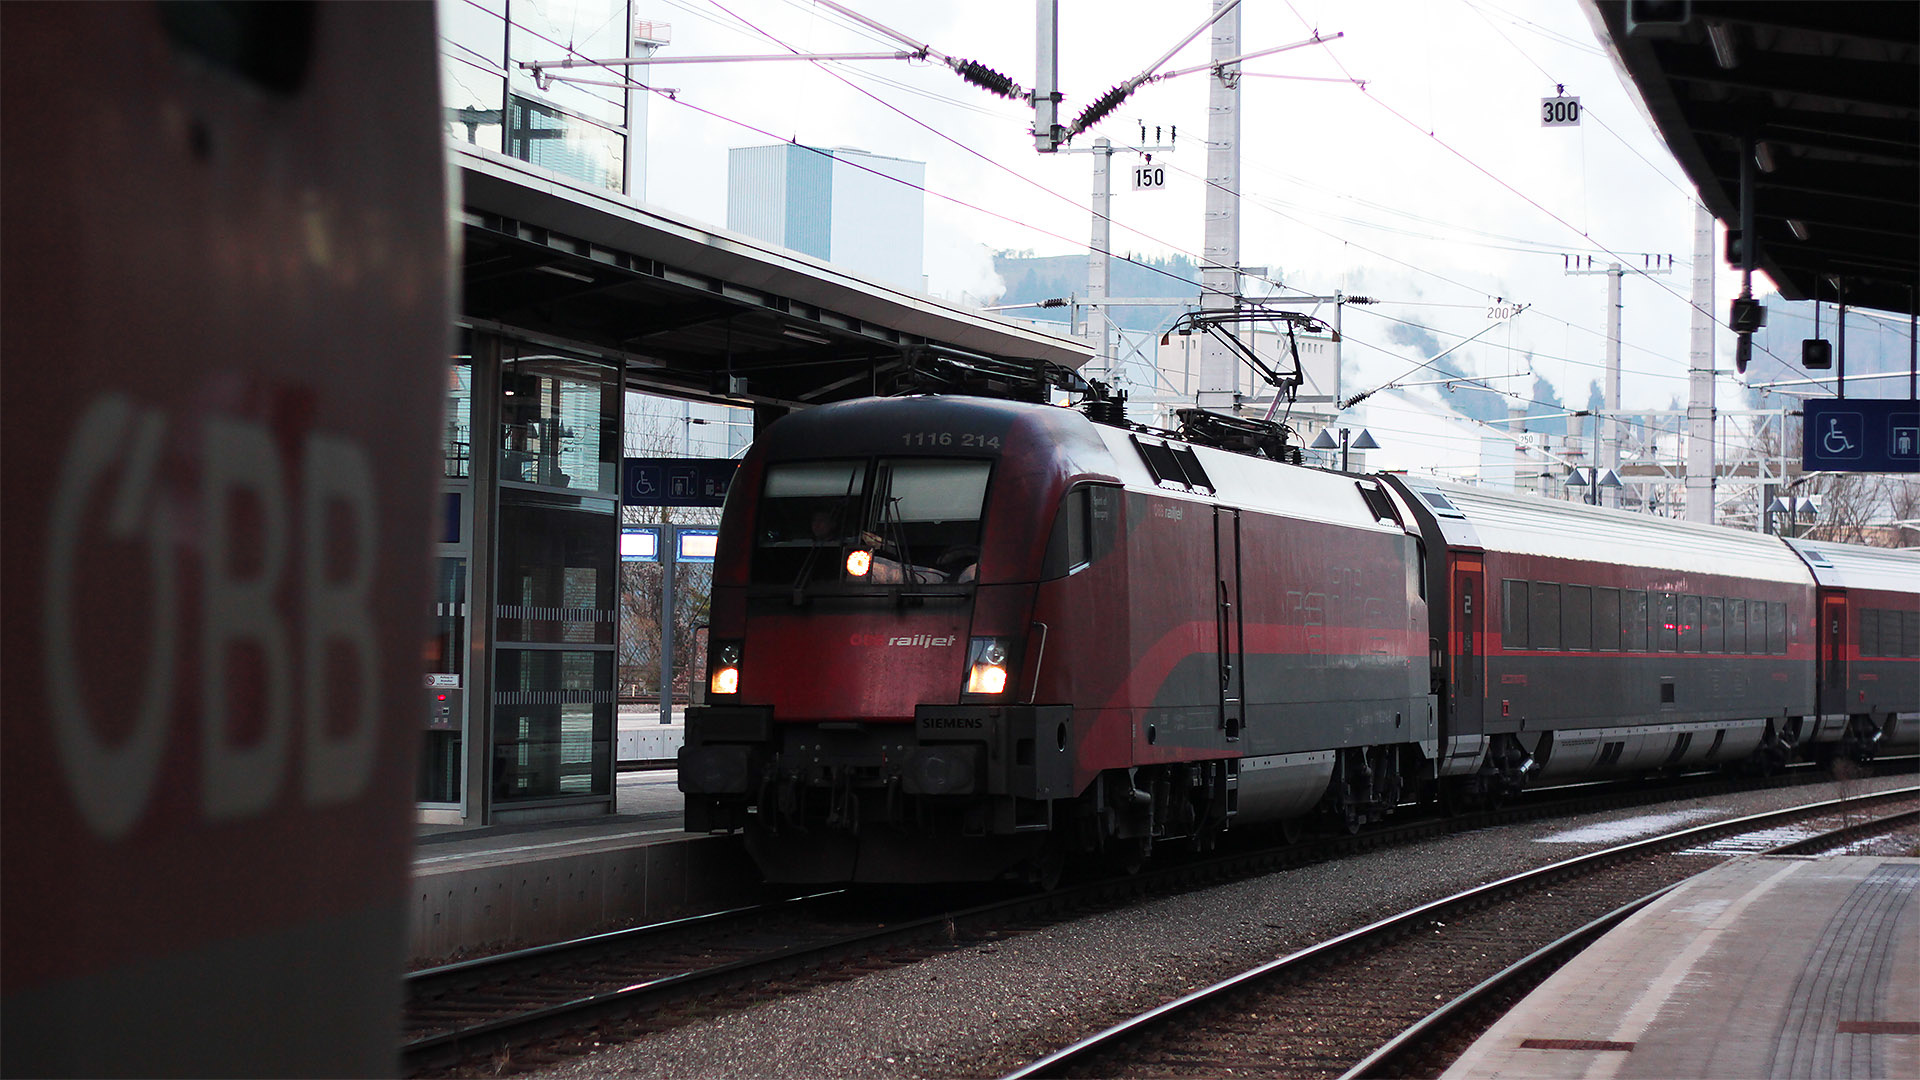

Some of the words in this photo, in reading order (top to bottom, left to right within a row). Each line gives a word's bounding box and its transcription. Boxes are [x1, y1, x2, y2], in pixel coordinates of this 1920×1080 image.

[1543, 101, 1578, 123] 300
[1135, 168, 1164, 187] 150
[1487, 306, 1509, 319] 200
[902, 432, 952, 446] 1116
[961, 433, 1000, 449] 214
[1464, 595, 1472, 614] 2
[1832, 620, 1839, 634] 2
[888, 634, 956, 649] railjet
[922, 717, 983, 729] SIEMENS
